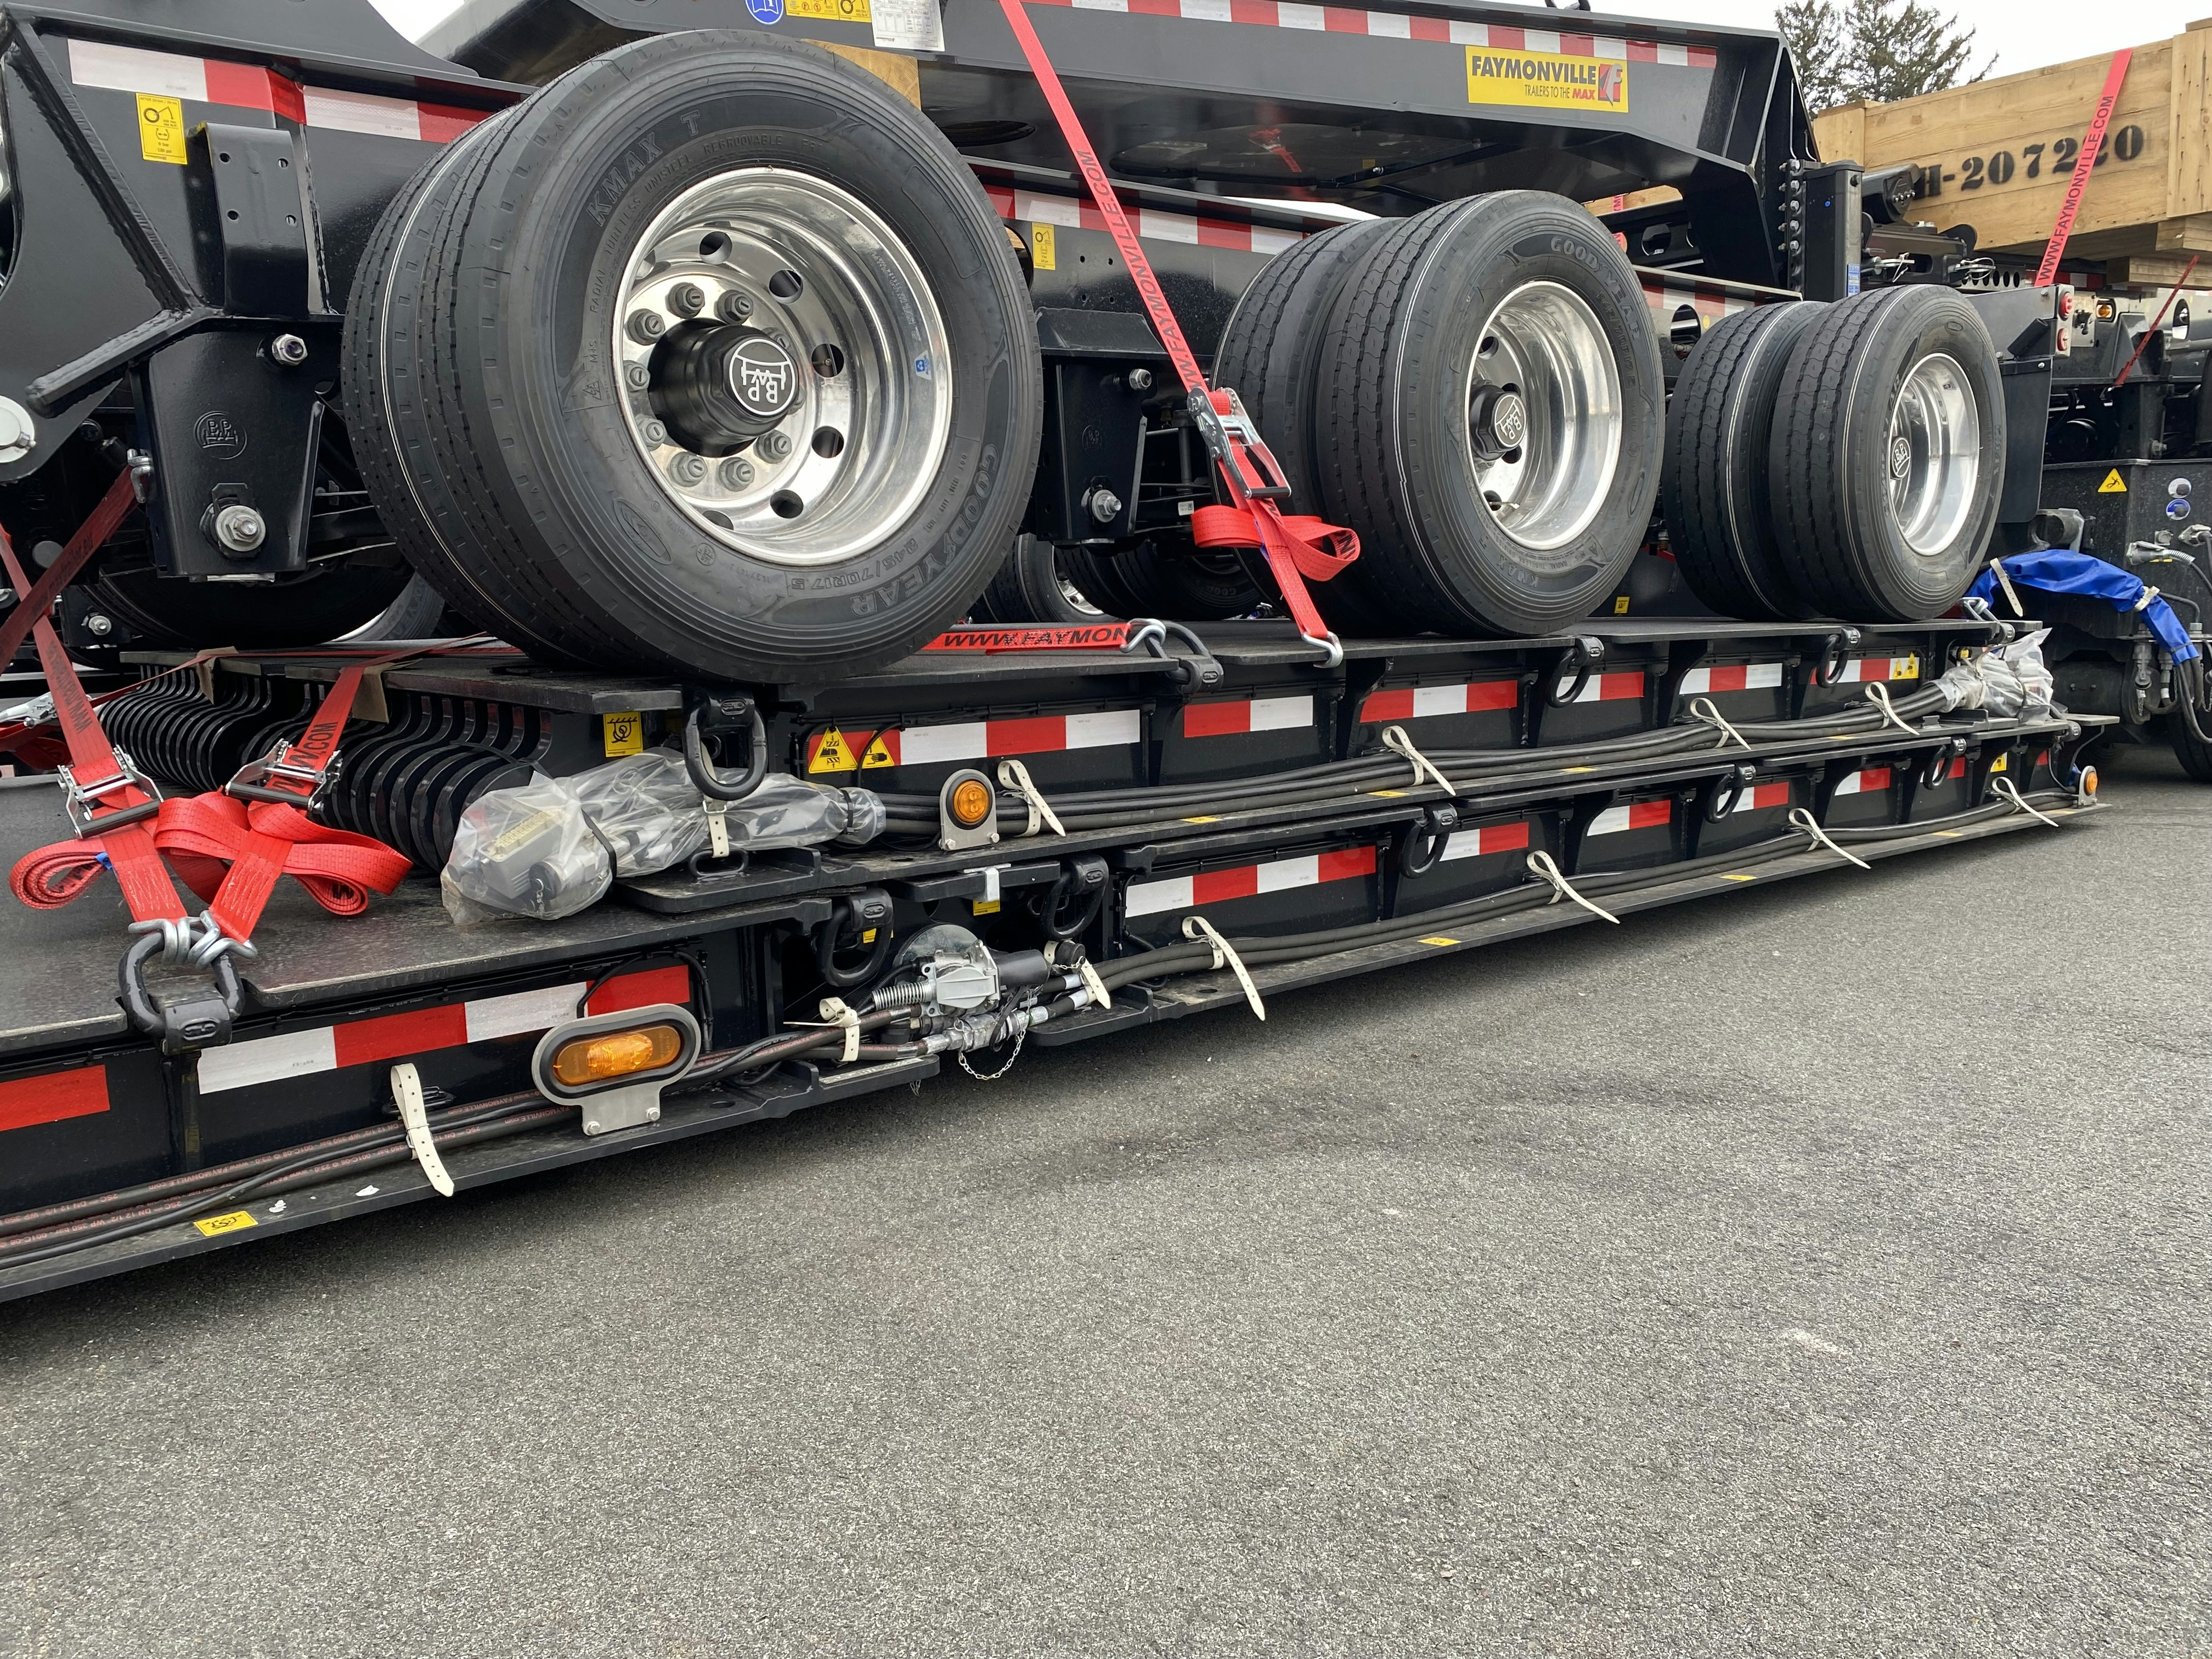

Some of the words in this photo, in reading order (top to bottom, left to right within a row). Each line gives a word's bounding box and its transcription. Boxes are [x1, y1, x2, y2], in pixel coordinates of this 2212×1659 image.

[1472, 55, 1596, 84] FAYMONVILLE
[1525, 84, 1550, 98] TRAILERS
[1550, 87, 1559, 98] TO
[1560, 88, 1570, 99] THE
[1572, 88, 1595, 100] MAX
[587, 132, 663, 227] KMAX
[680, 110, 701, 136] T
[2039, 95, 2114, 281] WWW.FAYMONVILLE.COM
[791, 538, 918, 590] 245/70R17.5
[850, 443, 1000, 617] GOODYEAR
